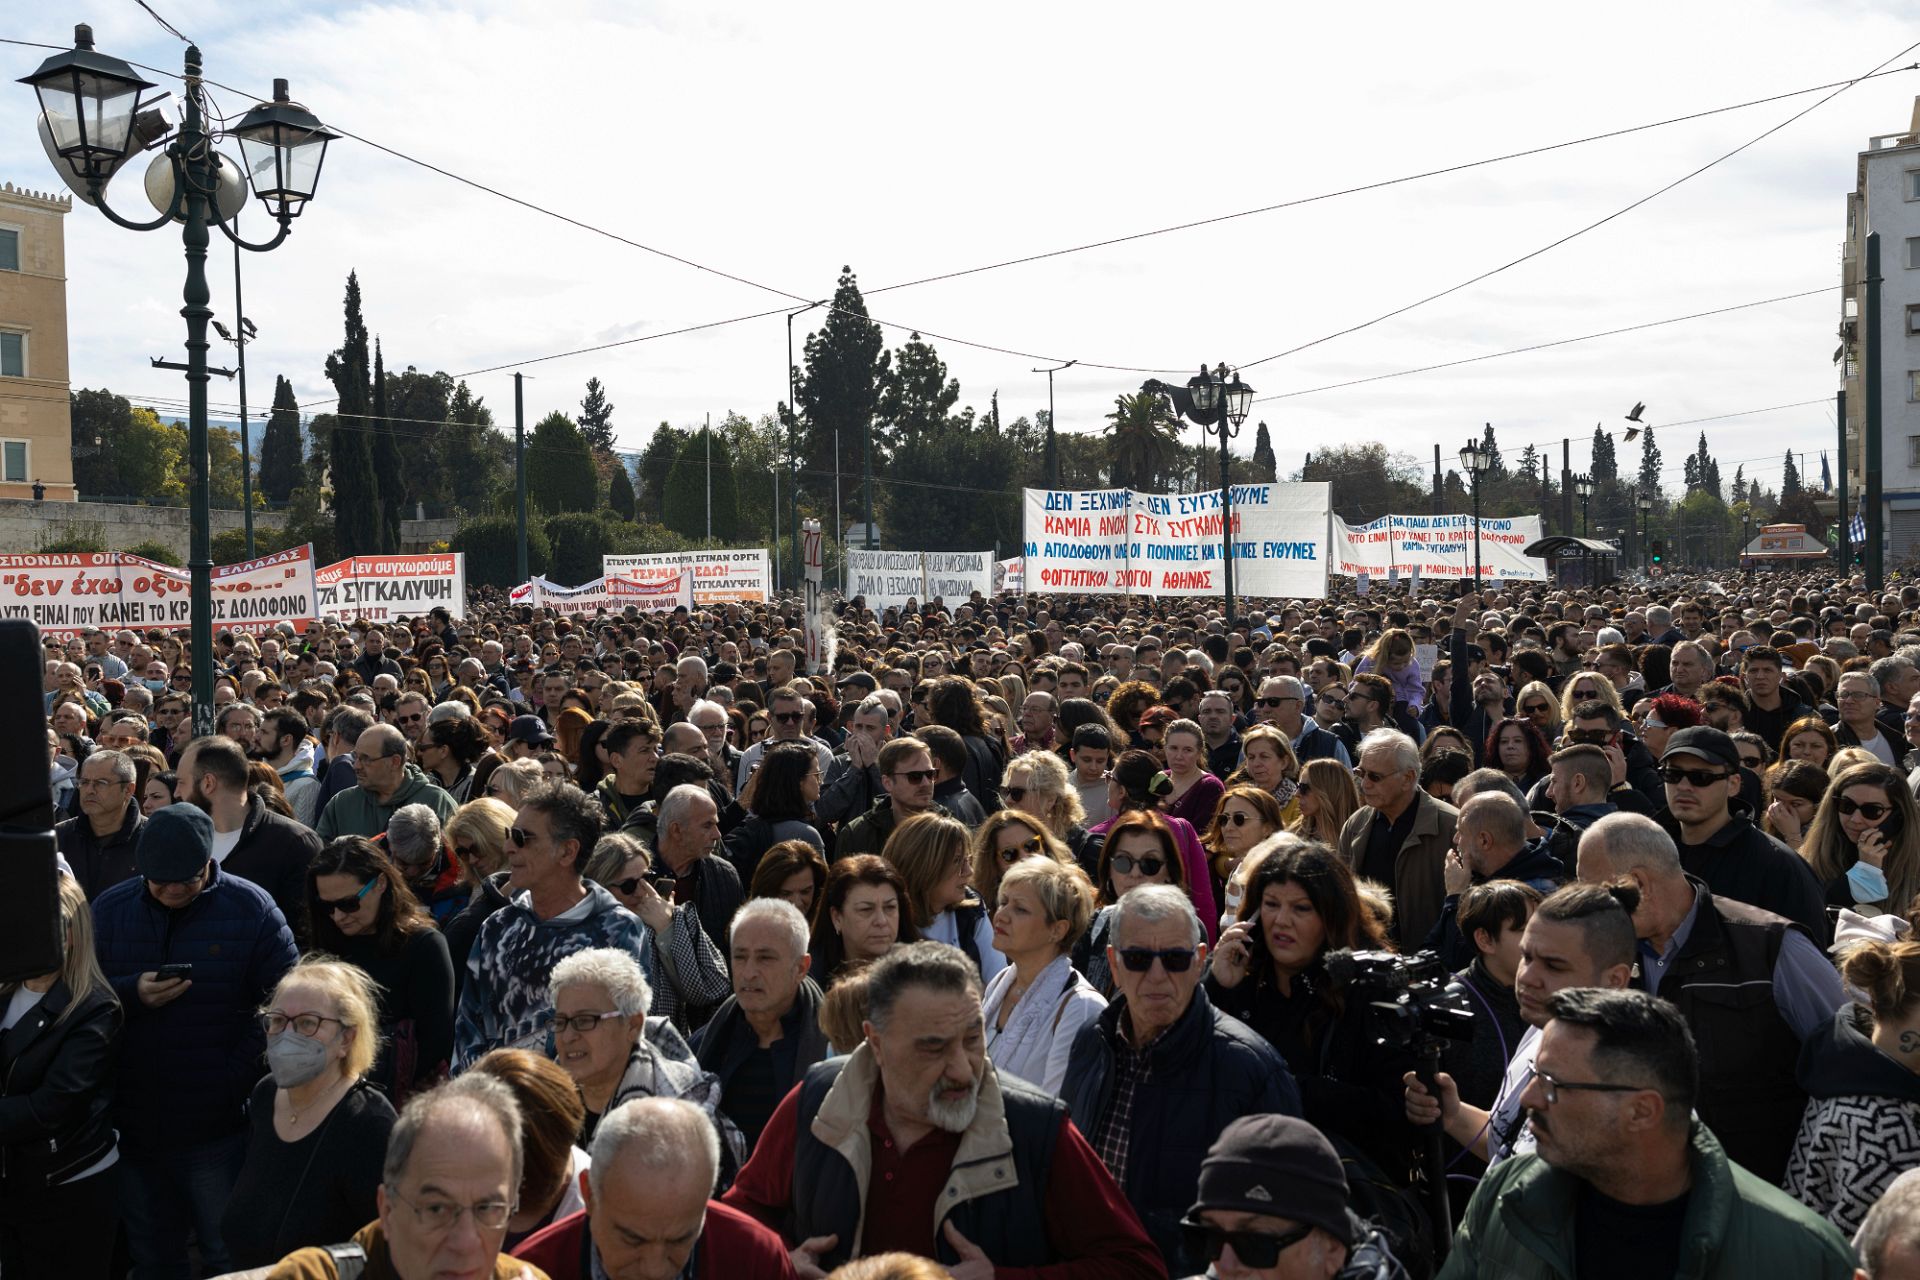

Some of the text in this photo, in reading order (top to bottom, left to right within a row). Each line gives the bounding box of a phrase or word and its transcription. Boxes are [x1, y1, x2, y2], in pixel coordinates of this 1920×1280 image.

[1045, 491, 1073, 511] ΔΕΝ
[1147, 496, 1171, 516] ΔΕΝ
[1044, 515, 1092, 537] ΚΑΜΙΑ
[1406, 516, 1430, 529] ΠΑΙΔΙ
[1432, 516, 1450, 528] ΔΕΝ
[1368, 531, 1388, 543] ΕΙΝΑΙ
[732, 553, 760, 561] ΟΡΓΗ
[1023, 541, 1038, 558] ΝΑ
[1043, 541, 1111, 560] ΑΠΟΔΟΘΟΥΝ
[1114, 543, 1128, 559] ΟΛΕ
[1130, 542, 1141, 559] ΟΙ
[1147, 543, 1199, 561] ΠΟΙΝΙΚΕΣ
[1201, 544, 1216, 561] ΚΑΙ
[1263, 541, 1317, 561] ΕΥΘΥΝΕΣ
[219, 549, 301, 577] ΕΛΛΑΔΑΣ
[375, 557, 453, 577] συγχωρούμε
[631, 567, 678, 579] ΤΕΡΜΑ
[70, 570, 123, 595] έχω
[1040, 567, 1109, 588] ΦΟΙΤΗΤΙΚΟΙ
[1162, 570, 1213, 590] ΑΘΗΝΑΣ
[343, 578, 452, 603] ΣΥΓΚΑΛΥΨΗ
[34, 604, 69, 625] ΕΙΝΑΙ
[100, 601, 145, 623] ΚΑΝΕΙ
[149, 603, 165, 622] ΤΟ
[169, 599, 225, 621] ΚΡΟΣ
[230, 594, 307, 619] ΔΟΛΟΦΟΝΟ
